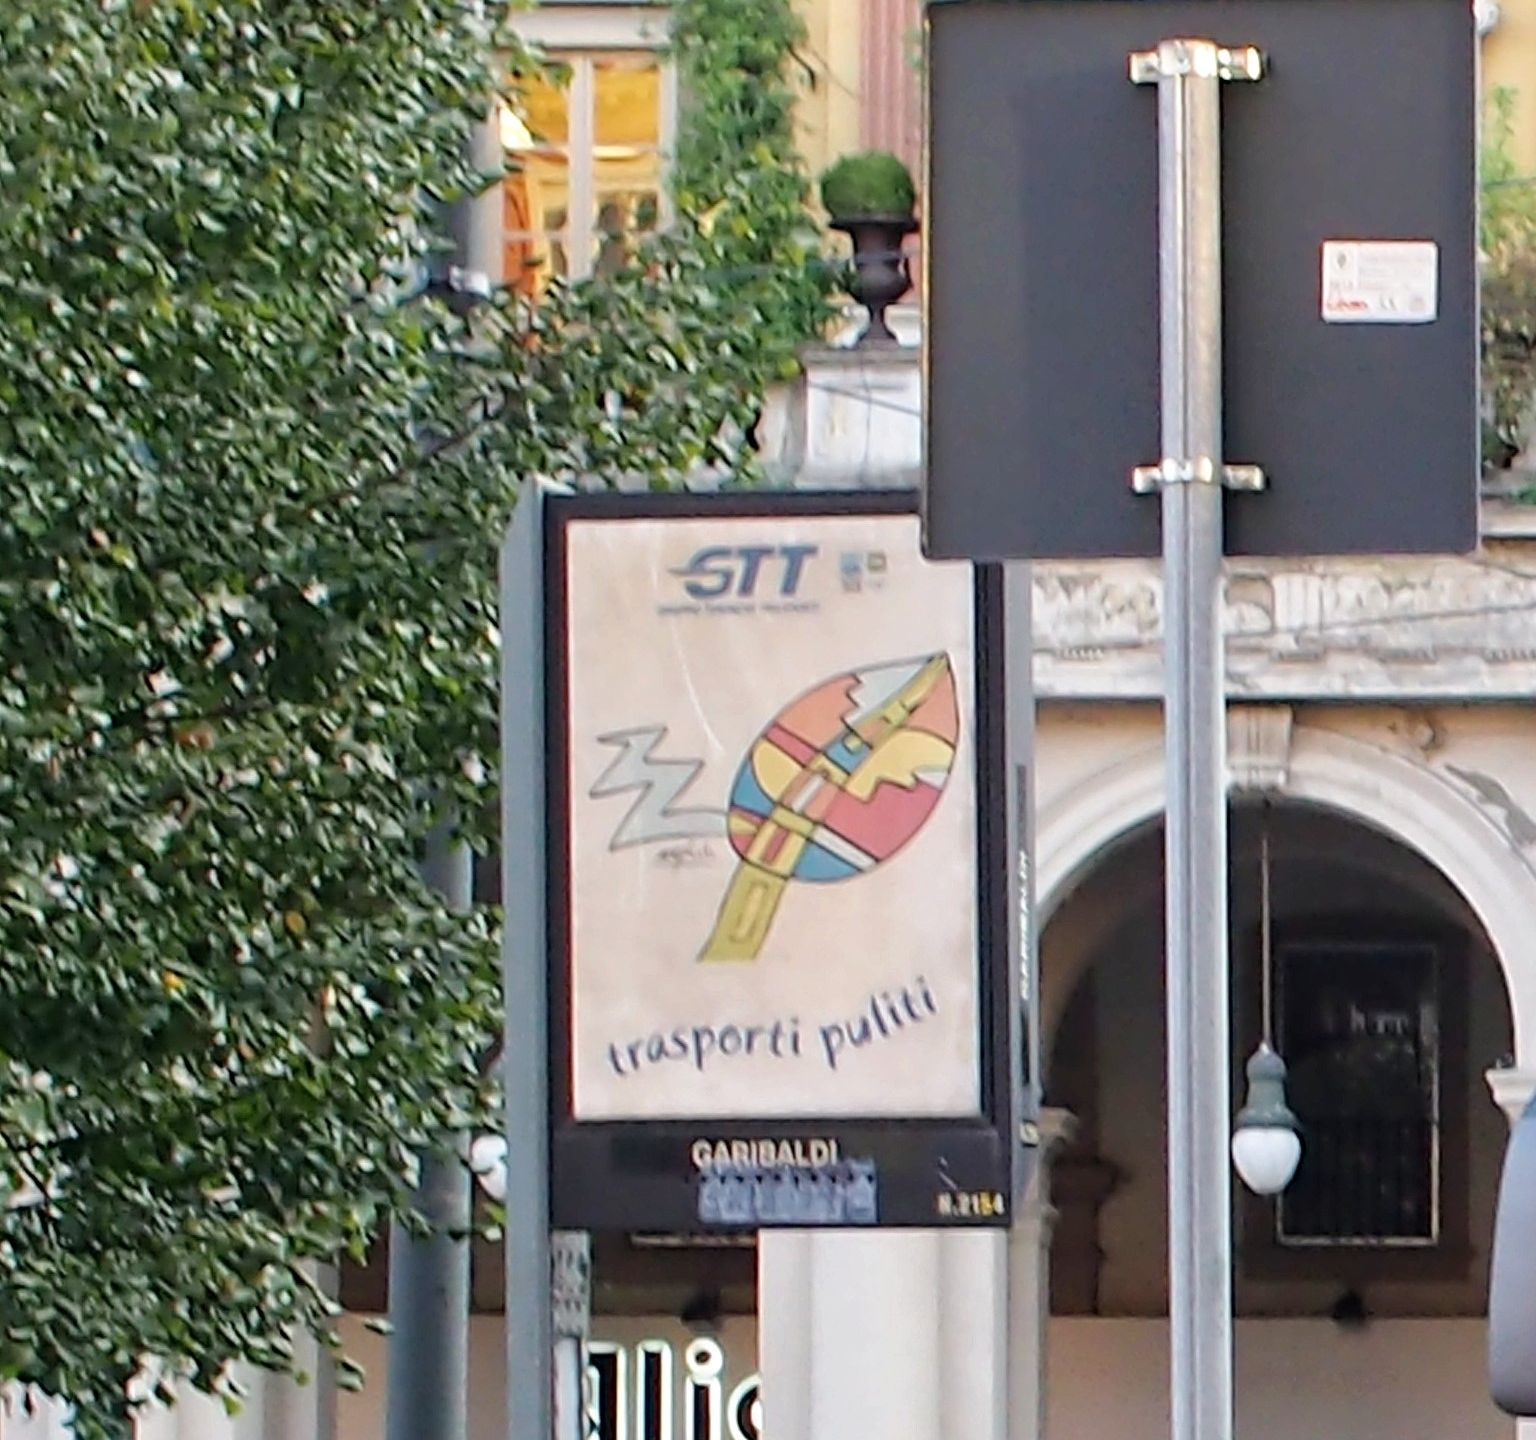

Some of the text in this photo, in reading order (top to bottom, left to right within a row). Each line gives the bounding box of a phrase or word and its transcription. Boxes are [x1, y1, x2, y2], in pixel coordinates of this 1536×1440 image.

[668, 545, 818, 600] STT
[609, 975, 937, 1075] trasporti puliti
[691, 1138, 838, 1169] GARIBALDI
